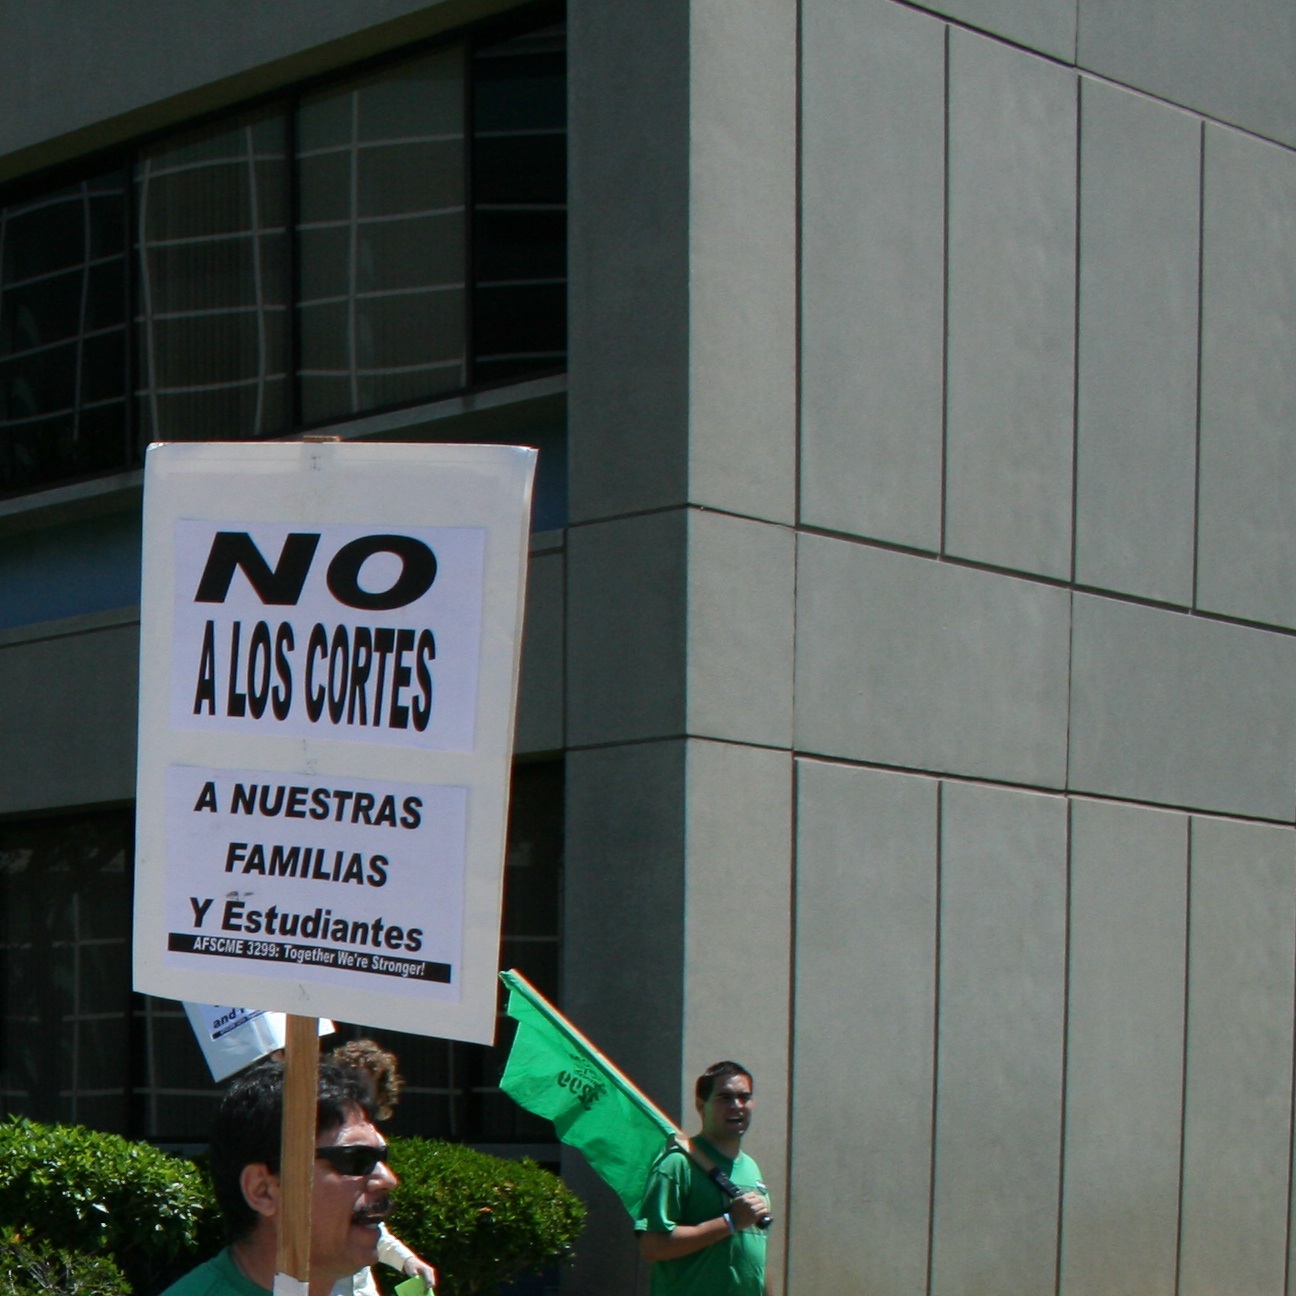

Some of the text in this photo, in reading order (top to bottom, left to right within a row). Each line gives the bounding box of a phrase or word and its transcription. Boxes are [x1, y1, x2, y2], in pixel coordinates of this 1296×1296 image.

[194, 531, 438, 611] NO
[193, 620, 437, 732] A LOS CORTES
[194, 782, 423, 829] A NUESTRAS
[224, 842, 390, 887] FAMILIAS
[189, 898, 423, 951] Y Estudiantes
[193, 937, 426, 977] AFSCME 3299: Together We're Stronger!
